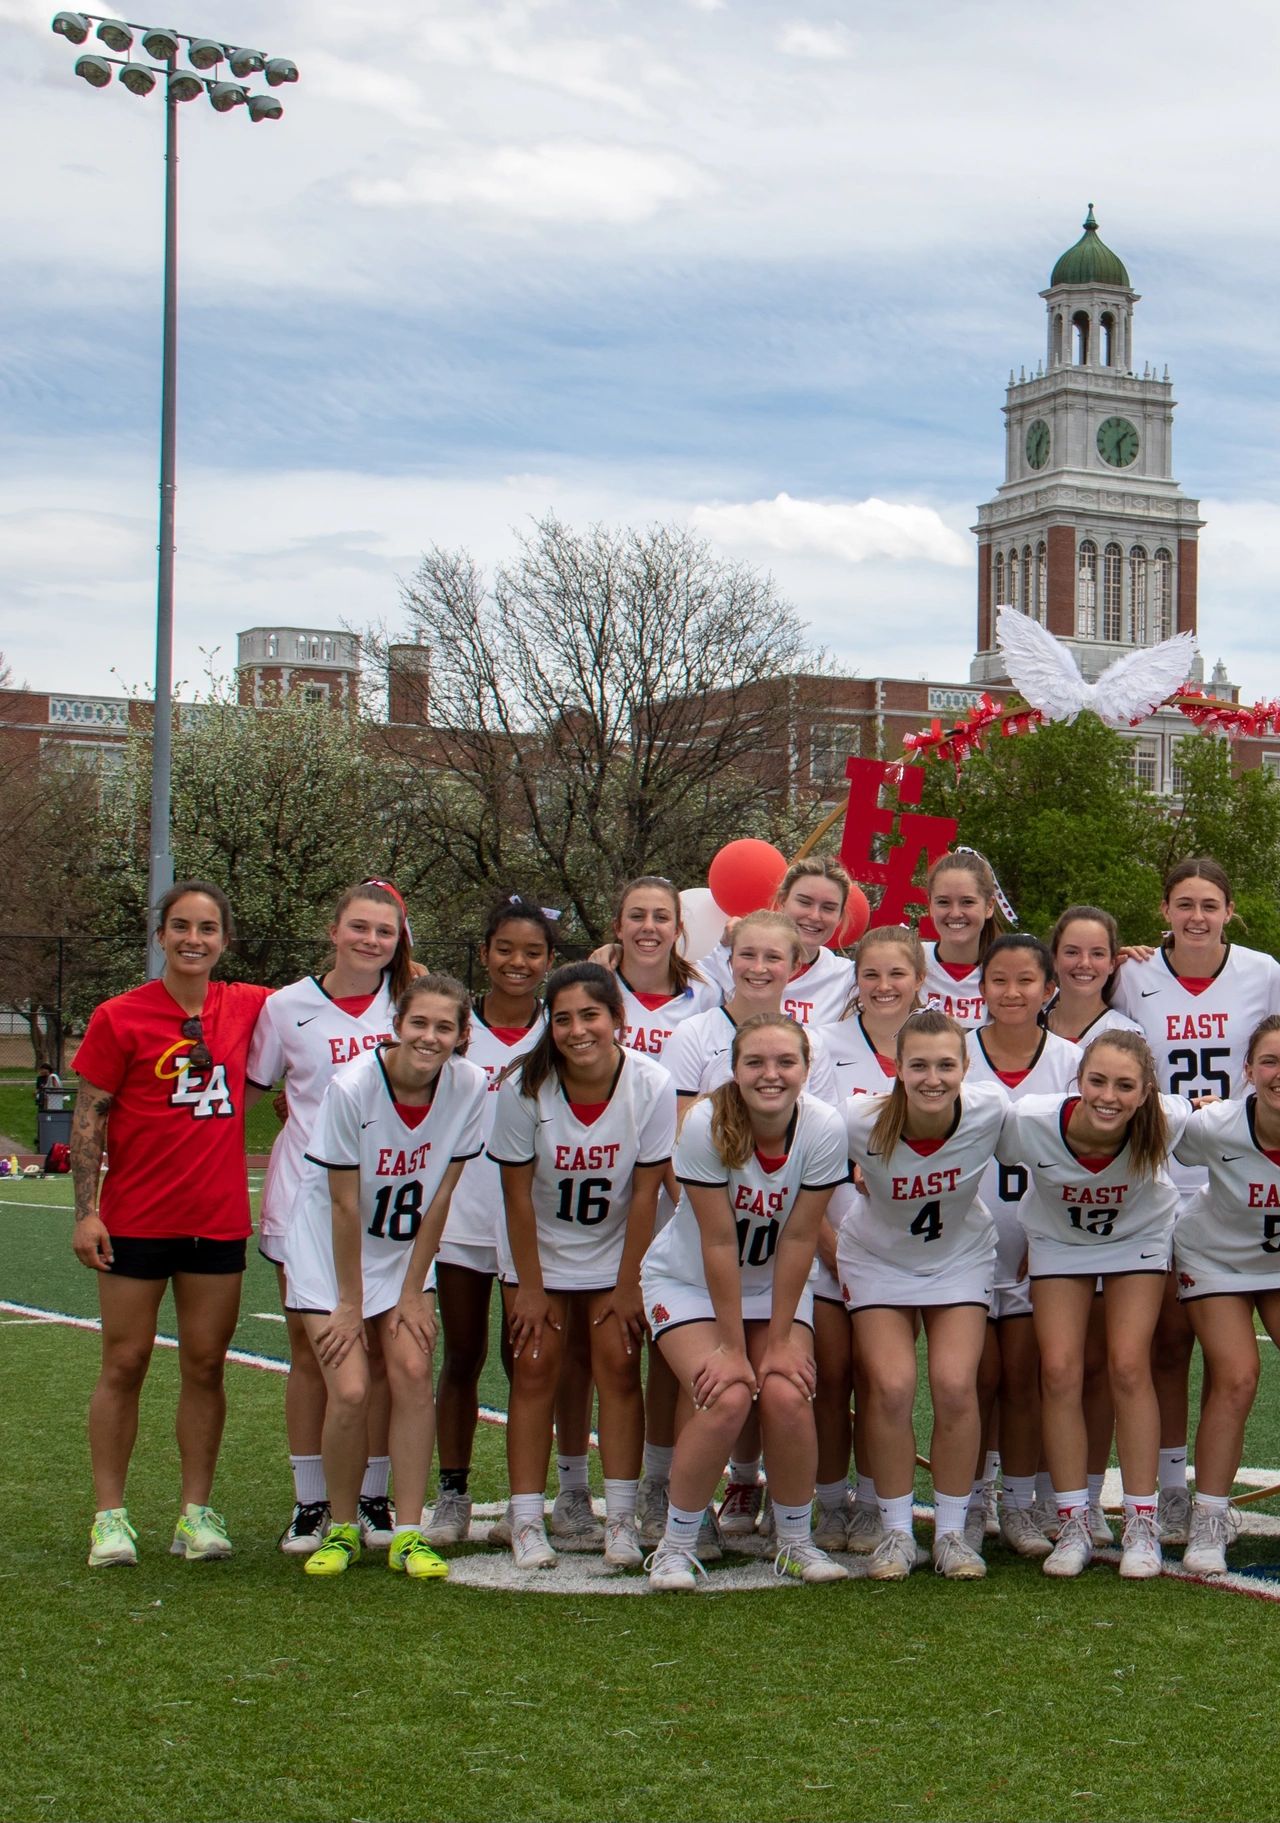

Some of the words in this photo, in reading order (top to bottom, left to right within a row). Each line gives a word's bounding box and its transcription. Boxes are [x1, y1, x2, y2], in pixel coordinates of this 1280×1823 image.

[784, 999, 813, 1024] ST
[1166, 1013, 1228, 1040] EAST
[171, 1057, 233, 1116] EA
[1168, 1048, 1230, 1100] 25
[376, 1142, 431, 1176] EAST
[554, 1143, 620, 1171] EAST
[892, 1168, 961, 1200] EAST
[1062, 1184, 1128, 1204] EAST
[368, 1180, 424, 1242] 18
[556, 1178, 612, 1225] 16
[911, 1200, 943, 1242] 4
